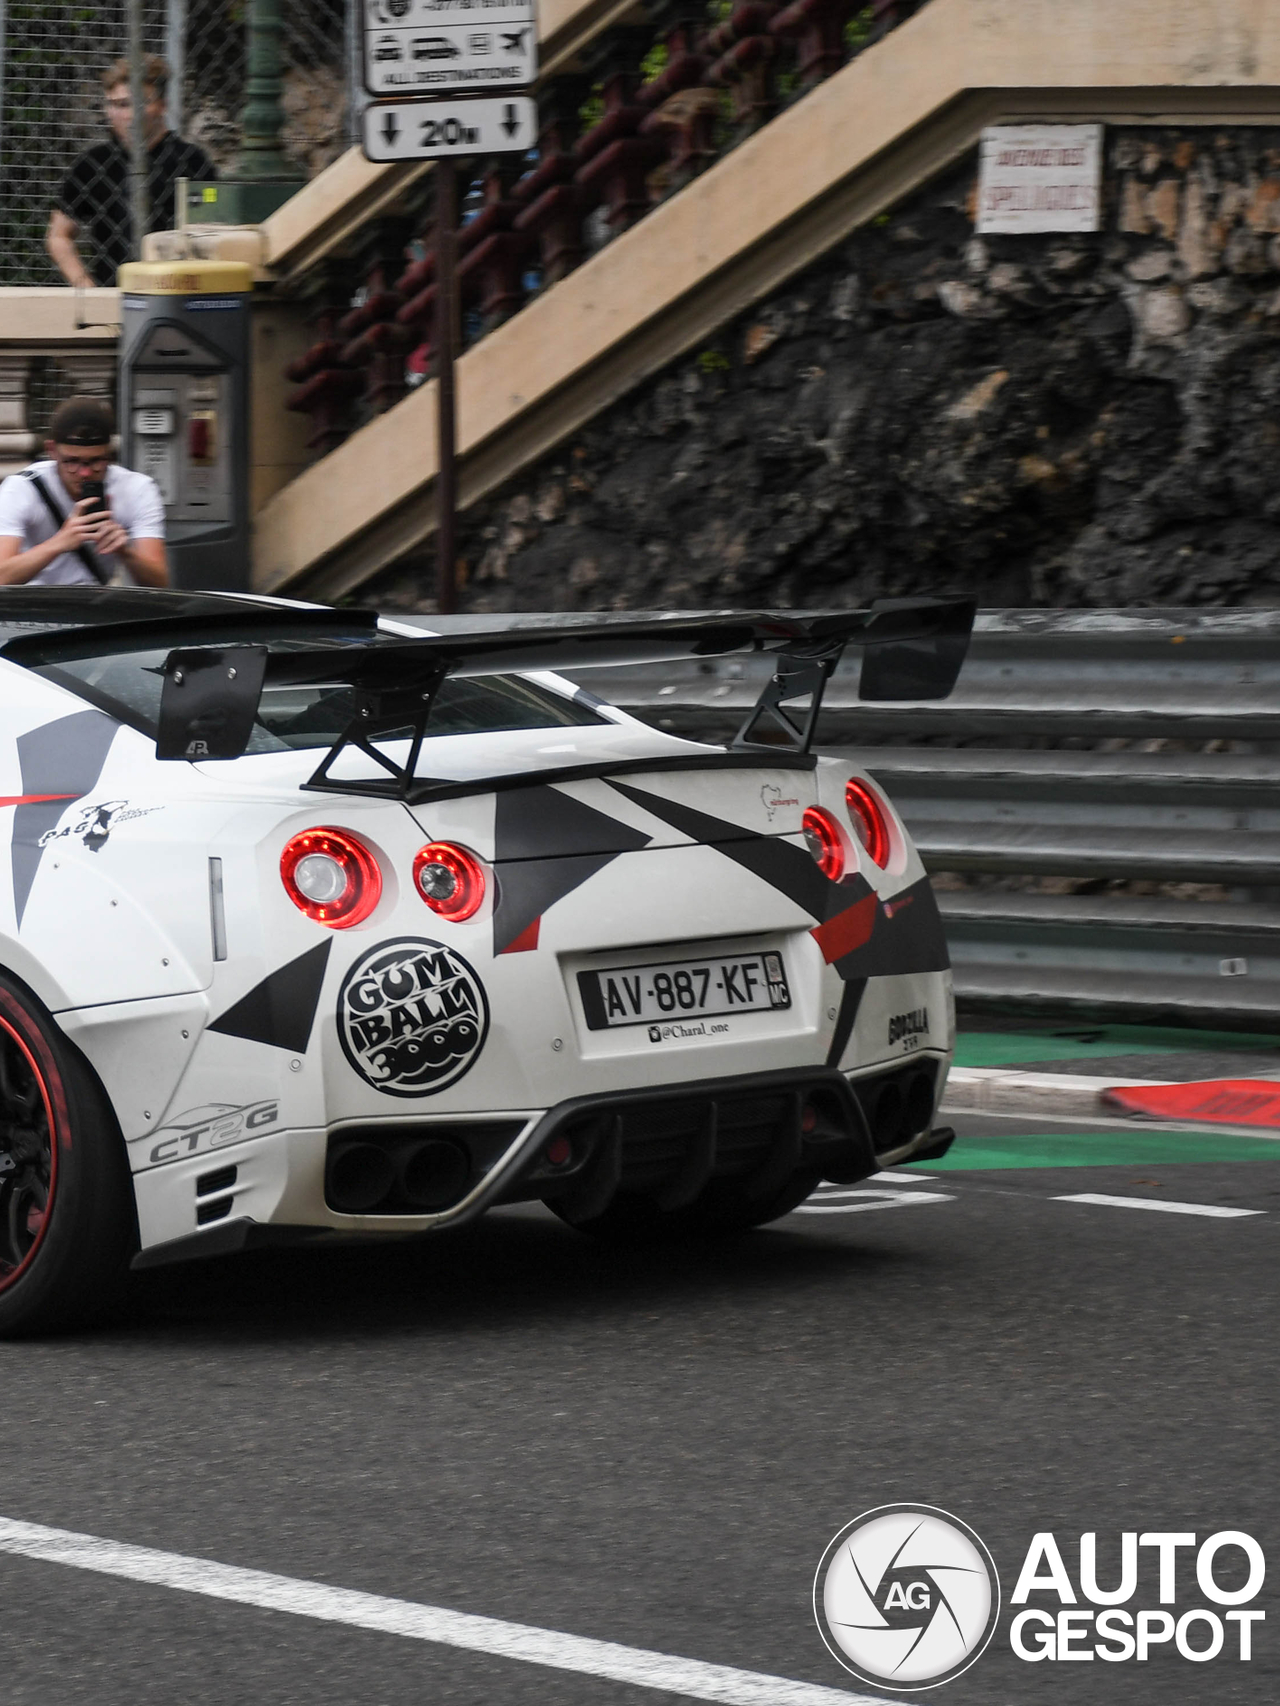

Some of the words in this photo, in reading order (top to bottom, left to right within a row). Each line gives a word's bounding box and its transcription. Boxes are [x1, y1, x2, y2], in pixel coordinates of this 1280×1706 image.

[346, 949, 463, 1014] GUM
[769, 984, 788, 1003] MC
[350, 976, 478, 1054] BALL
[662, 1023, 729, 1039] @Charal_one
[368, 1017, 479, 1084] 3000
[149, 1103, 278, 1163] CT2G
